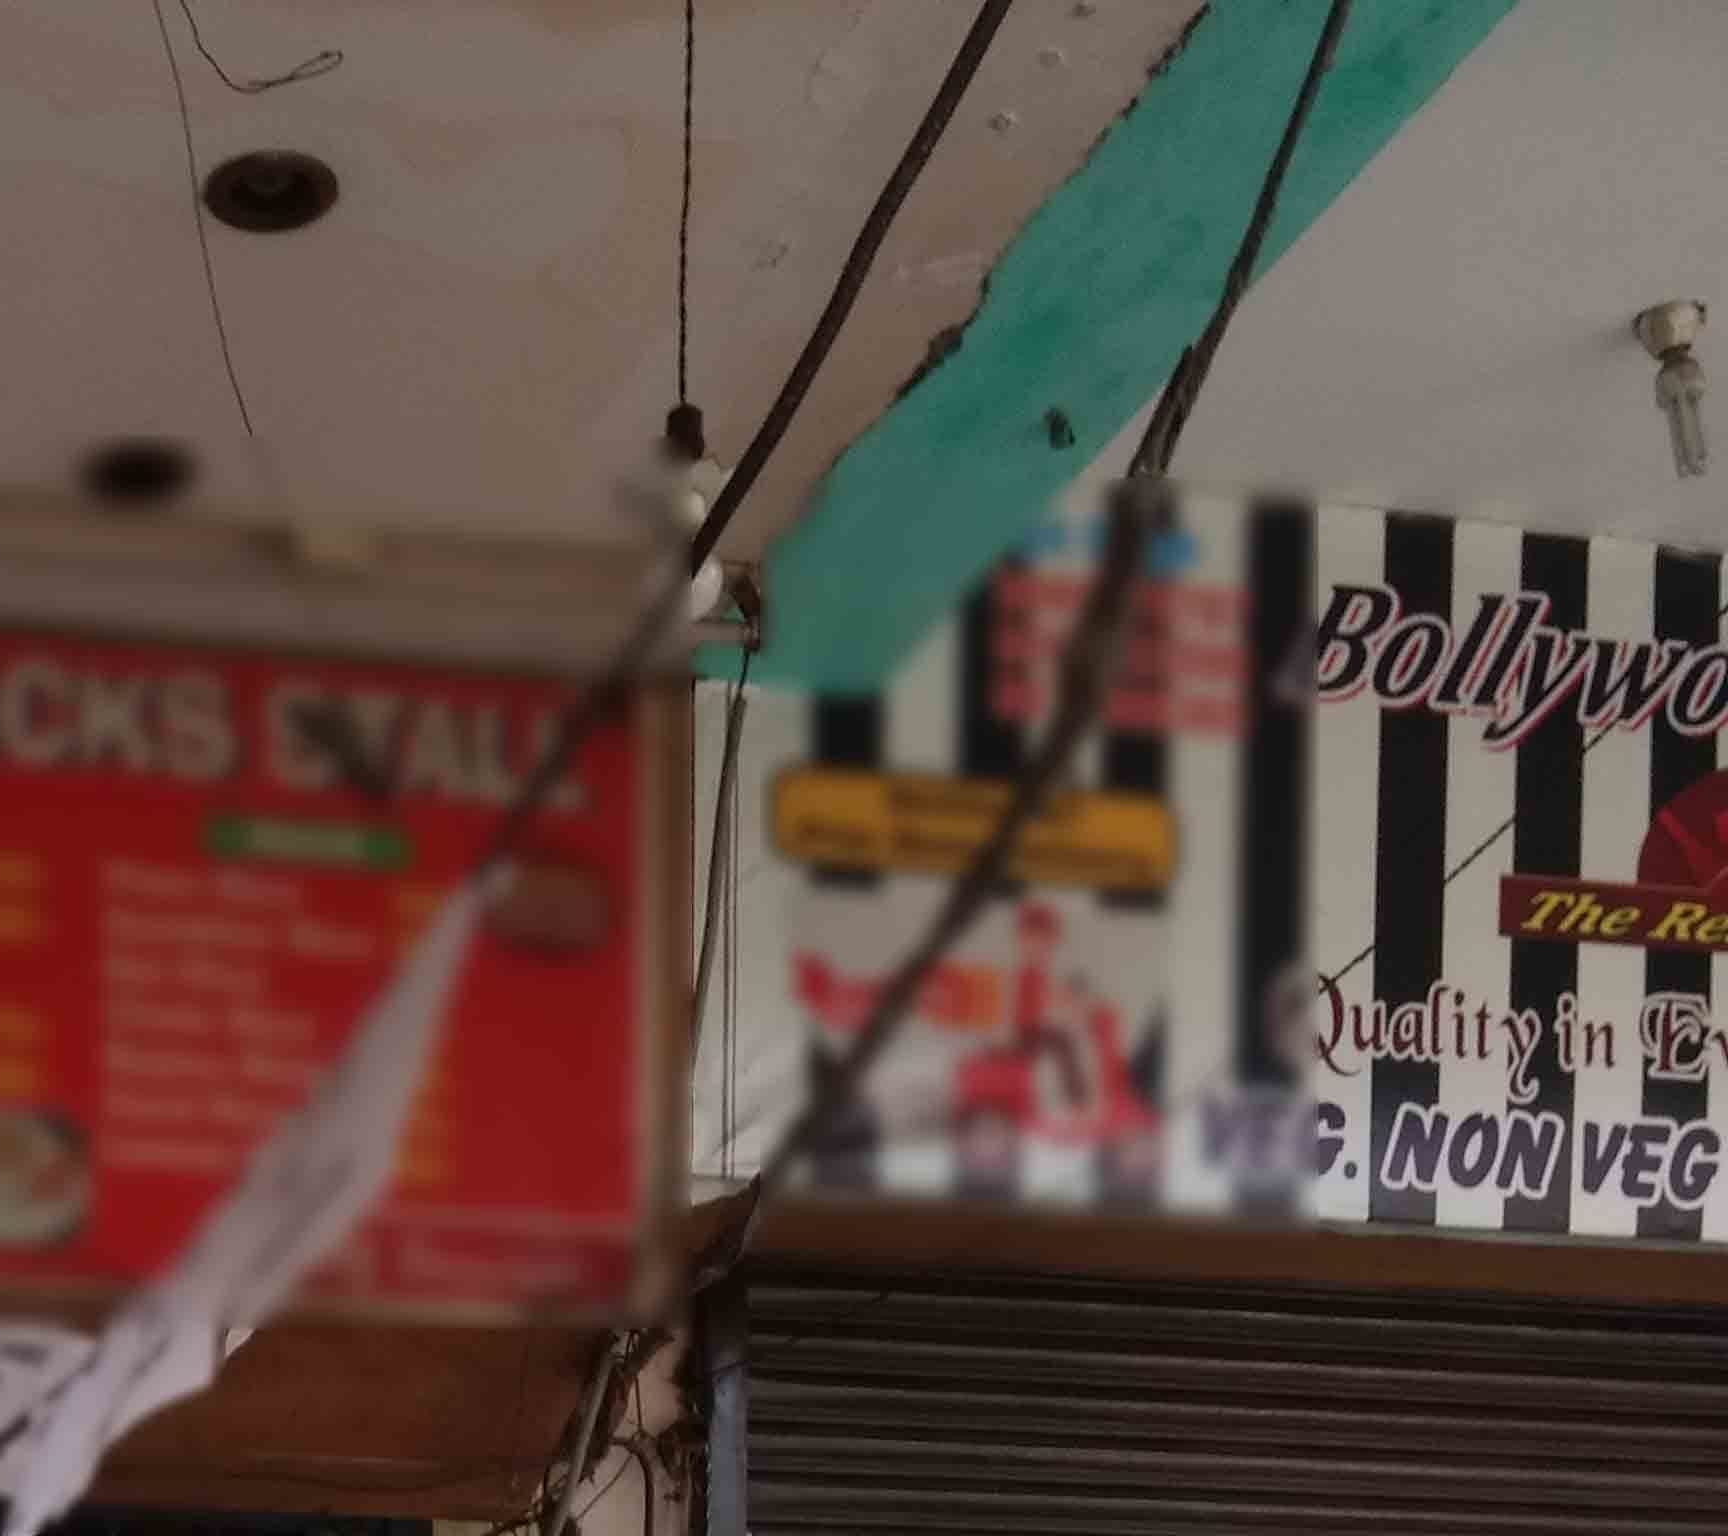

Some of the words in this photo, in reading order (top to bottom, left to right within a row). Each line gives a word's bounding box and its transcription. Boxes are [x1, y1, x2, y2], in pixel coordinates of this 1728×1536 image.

[1522, 890, 1642, 939] The
[1556, 994, 1616, 1072] in
[1384, 1103, 1562, 1200] NON
[1580, 1118, 1722, 1206] VEG
